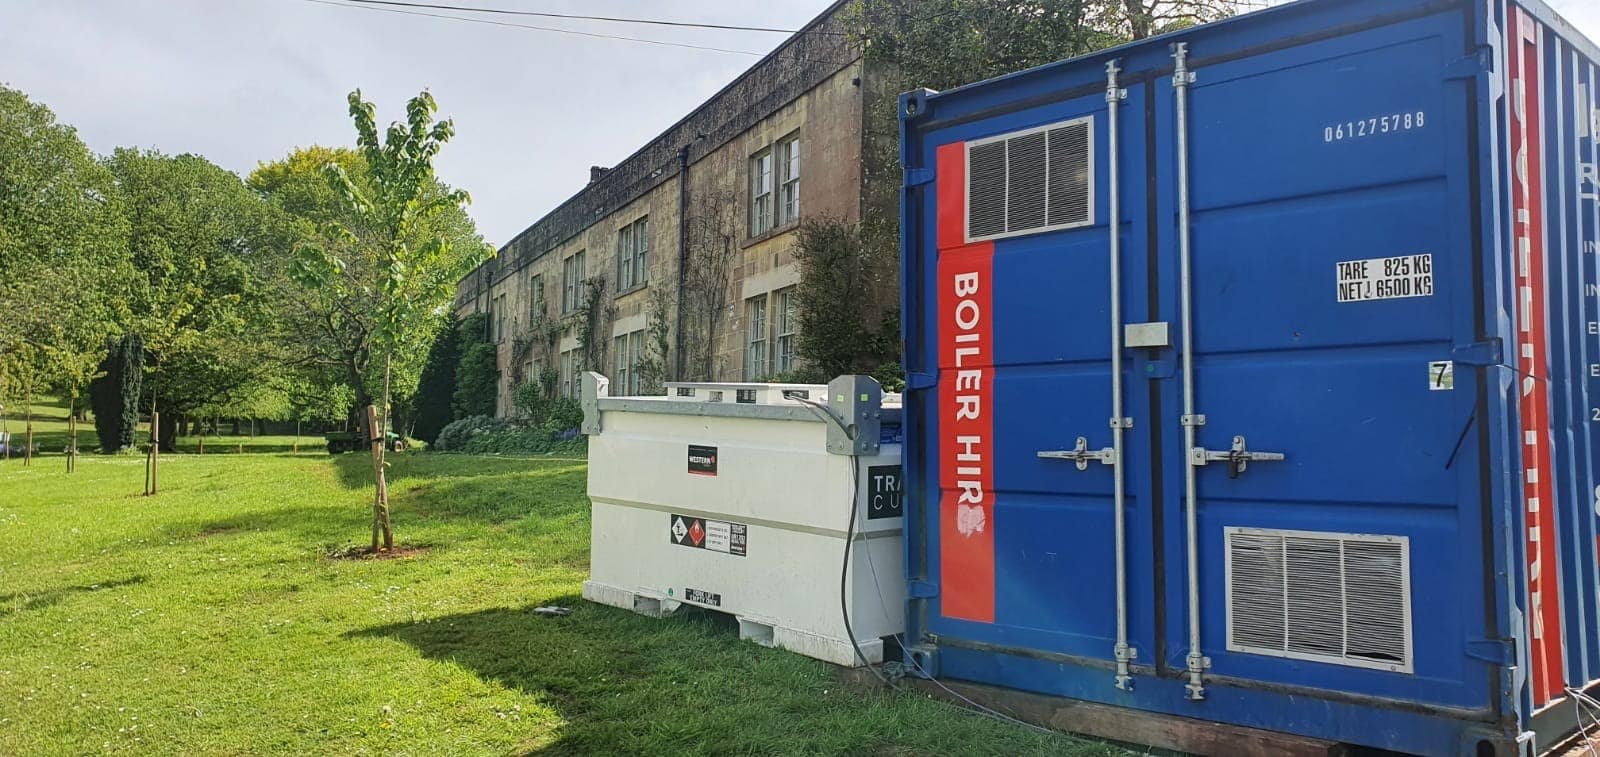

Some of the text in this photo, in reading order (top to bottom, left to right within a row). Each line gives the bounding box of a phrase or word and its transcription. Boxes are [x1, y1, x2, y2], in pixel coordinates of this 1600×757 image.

[1324, 111, 1424, 142] 061275788
[1338, 255, 1431, 281] TARE 825 KG
[1376, 278, 1410, 297] 6500
[1414, 275, 1432, 295] KG
[1432, 363, 1447, 387] 7
[954, 271, 986, 537] BOILER HIR
